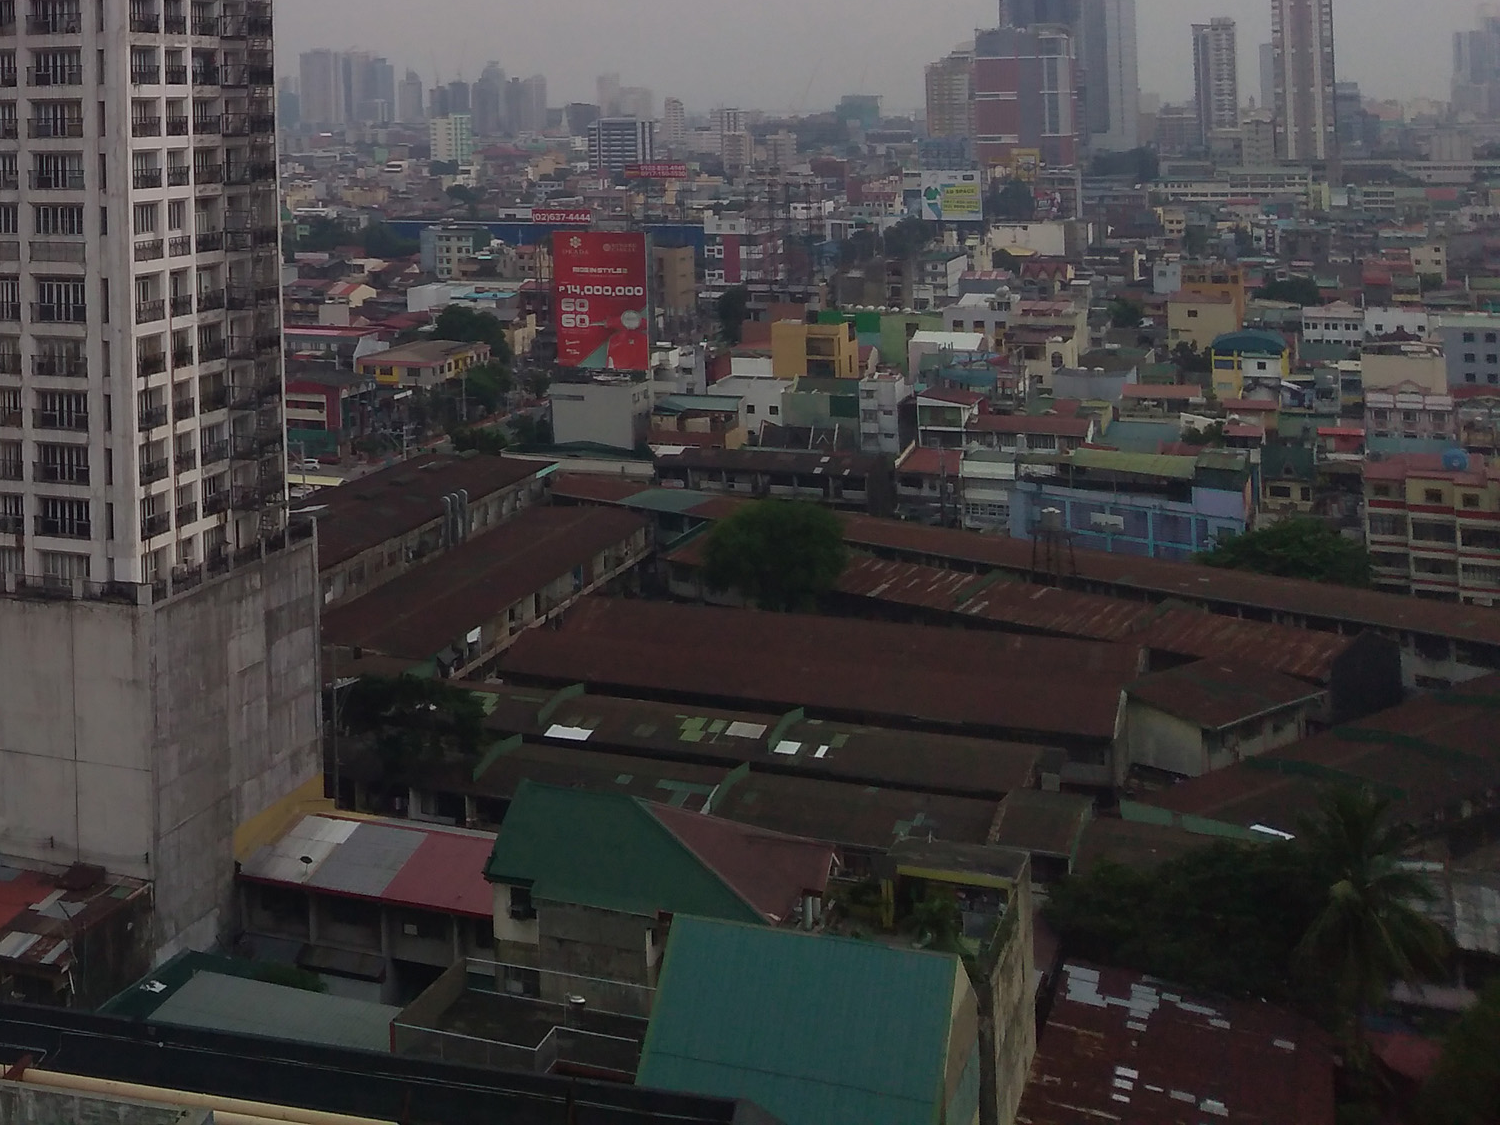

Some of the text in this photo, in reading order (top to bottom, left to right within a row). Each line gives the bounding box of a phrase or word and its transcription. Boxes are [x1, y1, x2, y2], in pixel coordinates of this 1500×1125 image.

[532, 213, 591, 222] (02)637-4444
[561, 298, 589, 312] 60
[561, 313, 590, 328] 60
